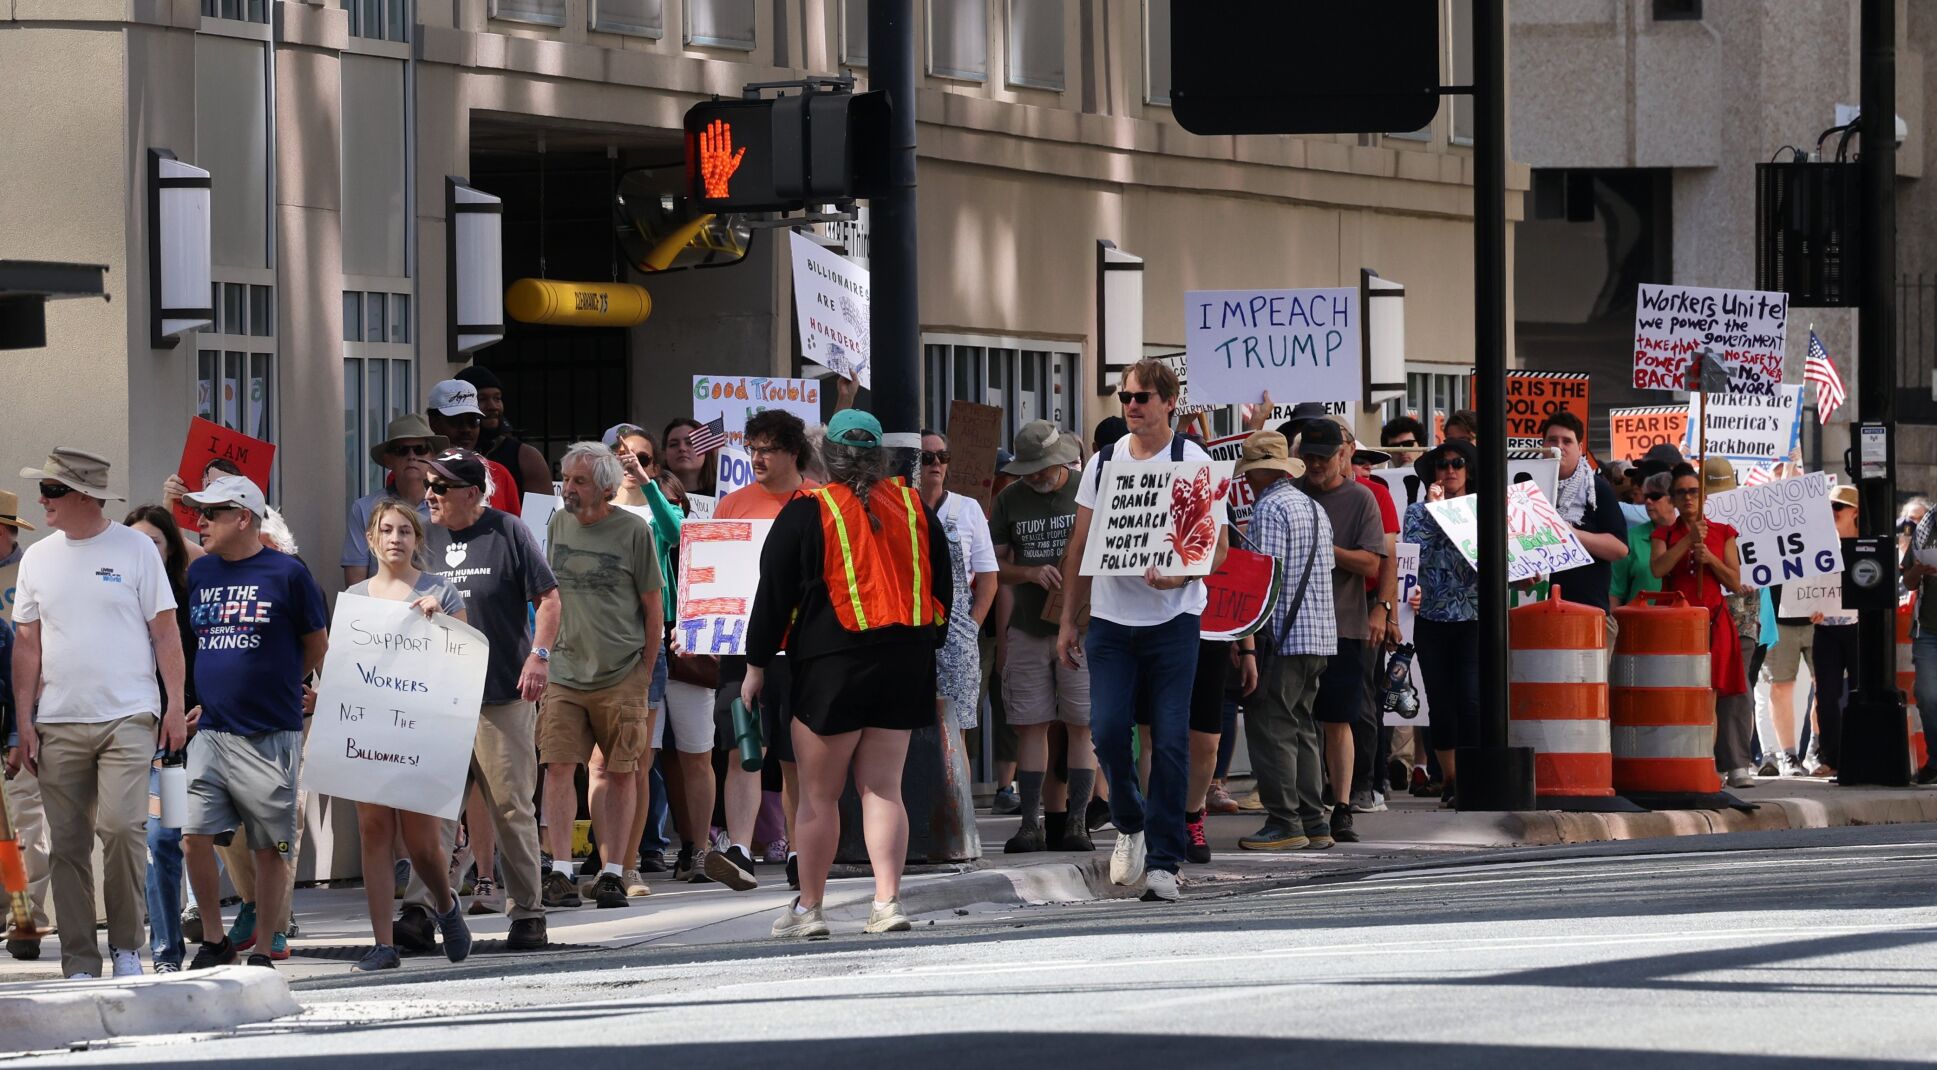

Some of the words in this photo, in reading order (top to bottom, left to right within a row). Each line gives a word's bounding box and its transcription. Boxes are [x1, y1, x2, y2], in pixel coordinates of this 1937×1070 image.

[817, 292, 836, 312] ARE
[1200, 294, 1348, 329] IMPEACH
[1642, 288, 1718, 319] Workers
[1722, 292, 1788, 330] Unite!
[809, 316, 861, 354] HOARDERS
[1669, 316, 1719, 335] power
[1724, 318, 1749, 333] the
[1214, 330, 1342, 369] TRUMP
[694, 377, 749, 401] Good
[750, 378, 818, 404] Trouble
[1528, 380, 1545, 397] IS
[1550, 381, 1586, 398] THE
[1727, 377, 1776, 397] WORK
[1706, 392, 1761, 407] orkers
[1615, 416, 1660, 434] FEAR
[1663, 415, 1680, 431] IS
[1705, 413, 1779, 432] America's
[223, 443, 249, 464] AM
[1116, 475, 1136, 490] THE
[1140, 472, 1171, 489] ONLY
[1111, 490, 1159, 511] ORANGE
[1704, 493, 1738, 520] OU
[1743, 474, 1826, 512] KNOW
[1016, 518, 1046, 535] STUDY
[1107, 511, 1167, 530] MONARCH
[1727, 503, 1806, 538] YOUR
[1105, 532, 1149, 551] WORTH
[1776, 532, 1806, 557] IS
[1100, 550, 1174, 570] FOLLOWING
[1397, 556, 1415, 570] THE
[1752, 549, 1836, 586] ONG
[455, 567, 492, 577] HUMANE
[200, 586, 223, 603] WE
[227, 584, 259, 601] THE
[1796, 585, 1842, 601] DICTAT
[209, 625, 236, 635] SERVE
[208, 633, 261, 650] KINGS
[439, 625, 470, 656] THE
[356, 662, 429, 693] WORKERS
[389, 708, 417, 730] THE
